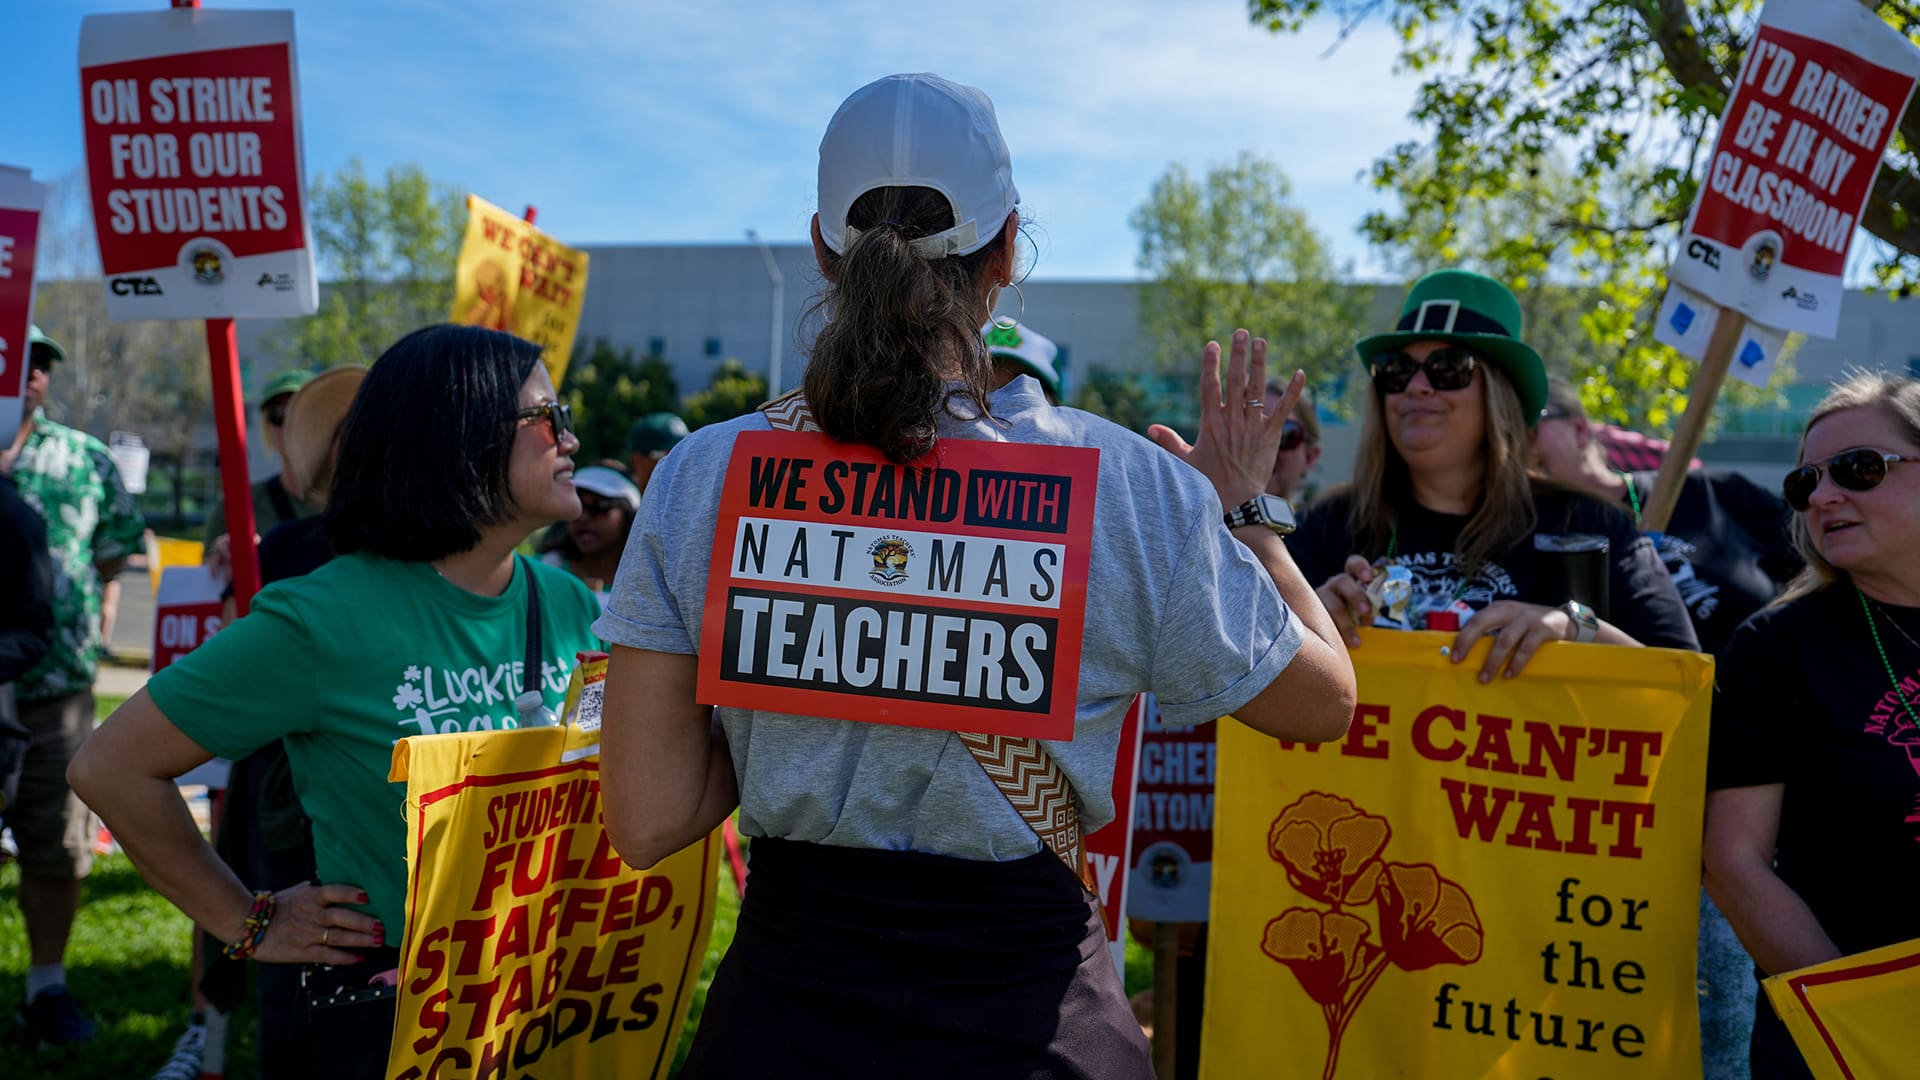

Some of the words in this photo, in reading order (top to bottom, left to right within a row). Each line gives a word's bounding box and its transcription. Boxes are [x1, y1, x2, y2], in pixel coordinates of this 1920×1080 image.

[90, 78, 141, 125] ON
[150, 77, 274, 124] STRIKE
[1745, 38, 1796, 98] I'D
[1789, 59, 1890, 152] RATHER
[110, 132, 181, 180] FOR
[188, 131, 263, 178] OUR
[1734, 100, 1782, 158] BE
[1776, 119, 1818, 174] IN
[1808, 136, 1857, 197] MY
[106, 185, 288, 235] STUDENTS
[1710, 149, 1854, 255] CLASSROOM
[748, 456, 814, 511] WE
[819, 461, 961, 523] STAND
[976, 477, 1061, 526] WITH
[161, 614, 198, 649] ON
[732, 594, 1049, 705] TEACHERS
[1411, 704, 1664, 788] CAN'T
[483, 778, 605, 850] STUDENT
[1440, 777, 1656, 860] WAIT
[471, 827, 624, 912] FULL
[1555, 878, 1650, 932] for
[410, 875, 685, 996] STAFFED,
[1540, 940, 1647, 996] the
[393, 983, 664, 1080] CHOOLS
[413, 934, 646, 1056] STABLE
[1432, 982, 1647, 1060] future
